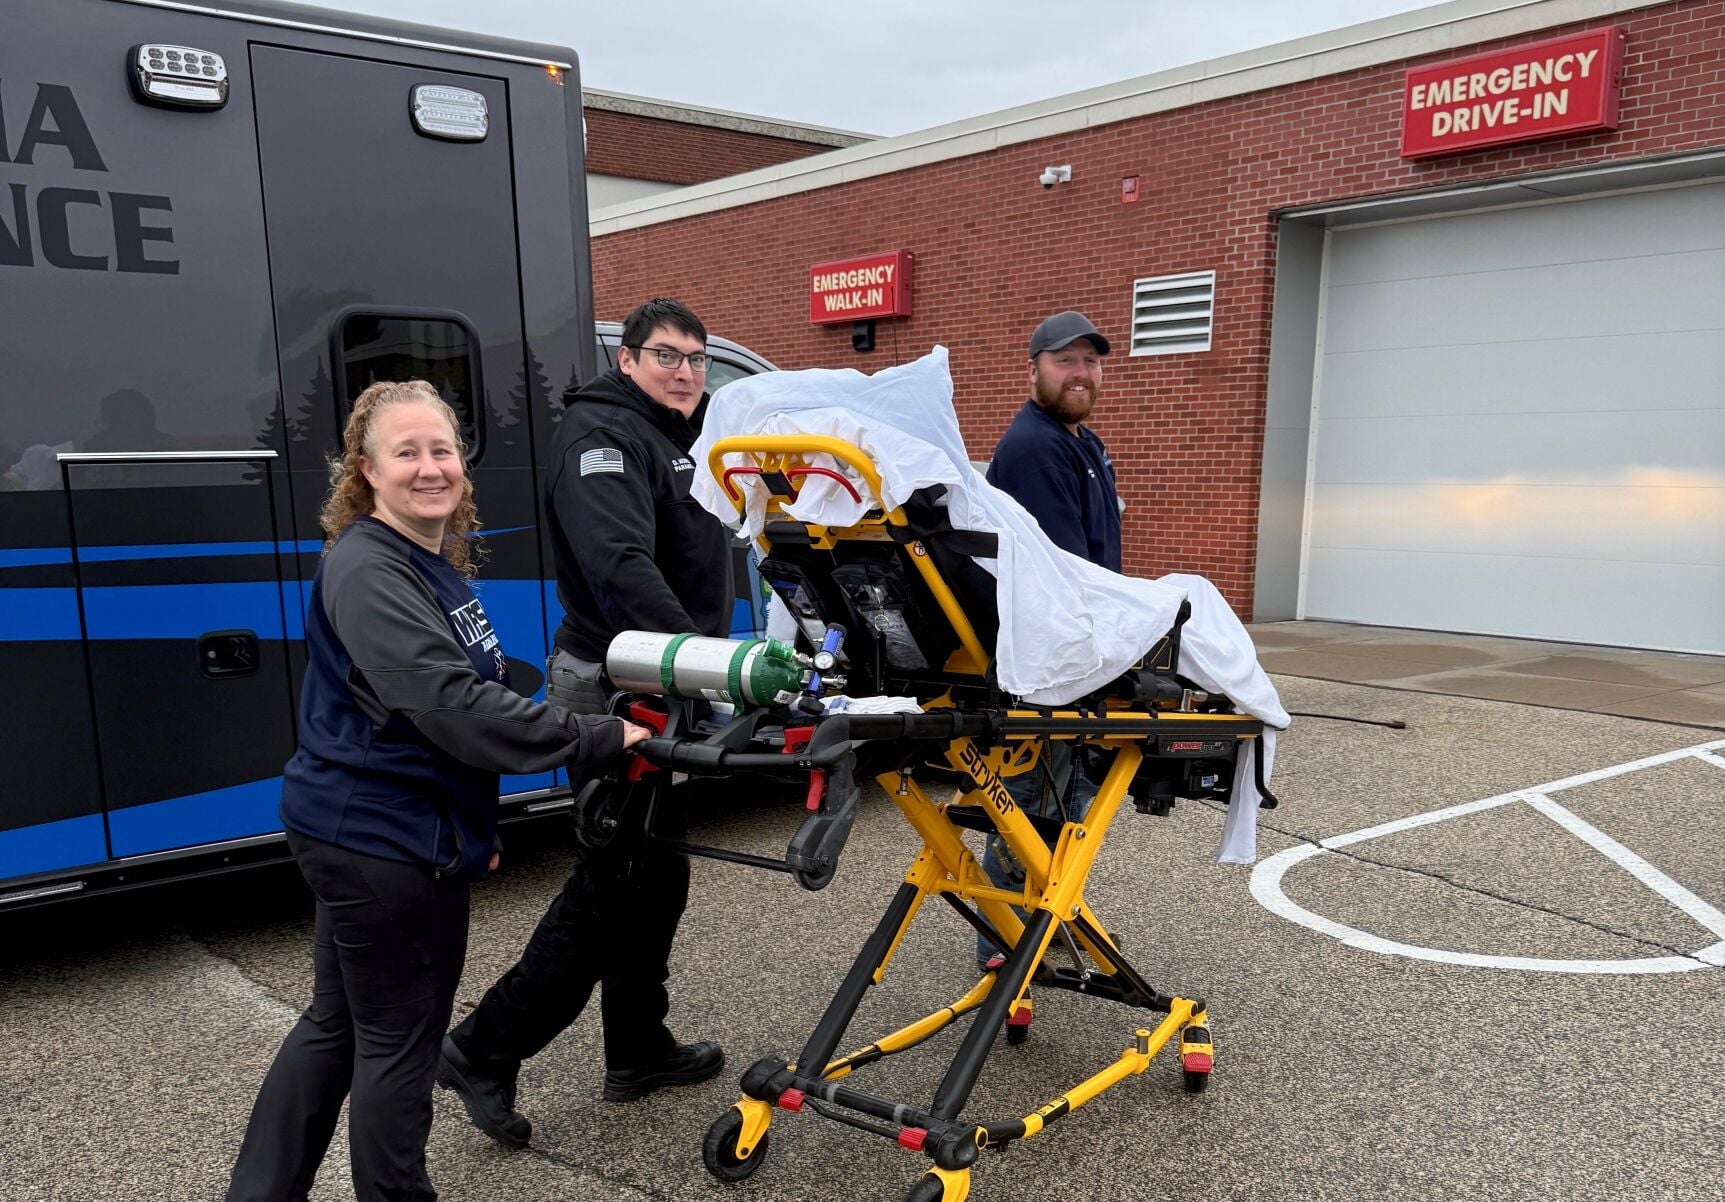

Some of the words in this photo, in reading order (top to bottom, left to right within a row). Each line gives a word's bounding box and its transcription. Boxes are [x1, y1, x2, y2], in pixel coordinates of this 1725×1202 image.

[1410, 49, 1599, 111] EMERGENCY
[0, 77, 109, 172] A
[1431, 88, 1569, 138] DRIVE-IN
[812, 264, 895, 293] EMERGENCY
[824, 287, 883, 312] WALK-IN
[959, 742, 1014, 815] stryker
